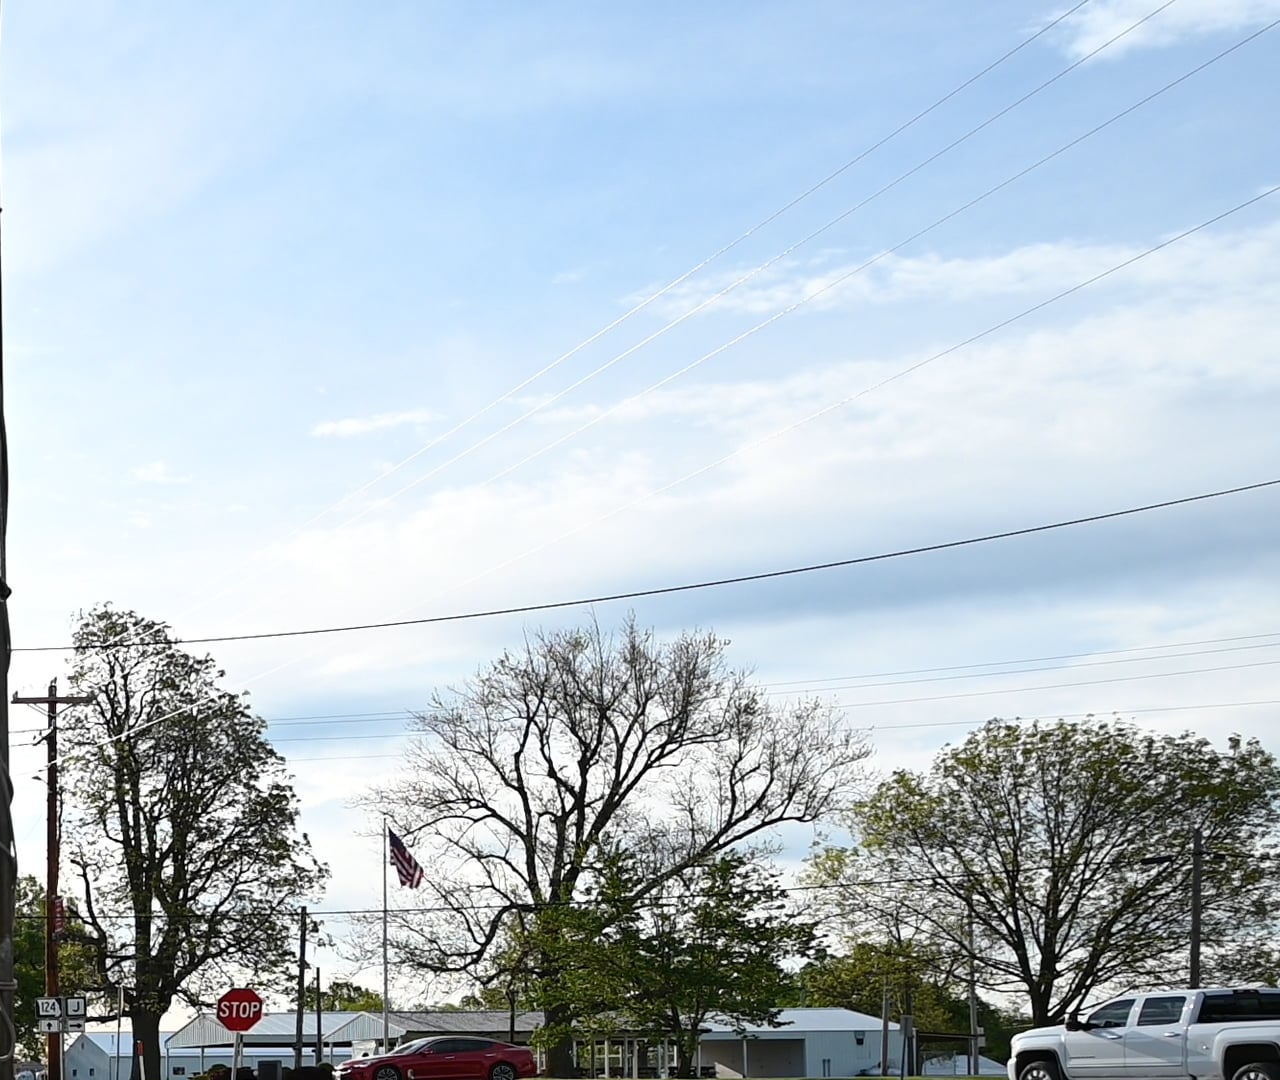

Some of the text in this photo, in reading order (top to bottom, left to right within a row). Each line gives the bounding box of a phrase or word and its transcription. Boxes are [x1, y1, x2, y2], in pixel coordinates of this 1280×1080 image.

[41, 1001, 56, 1013] 124
[72, 1001, 80, 1012] J
[219, 1001, 260, 1018] STOP
